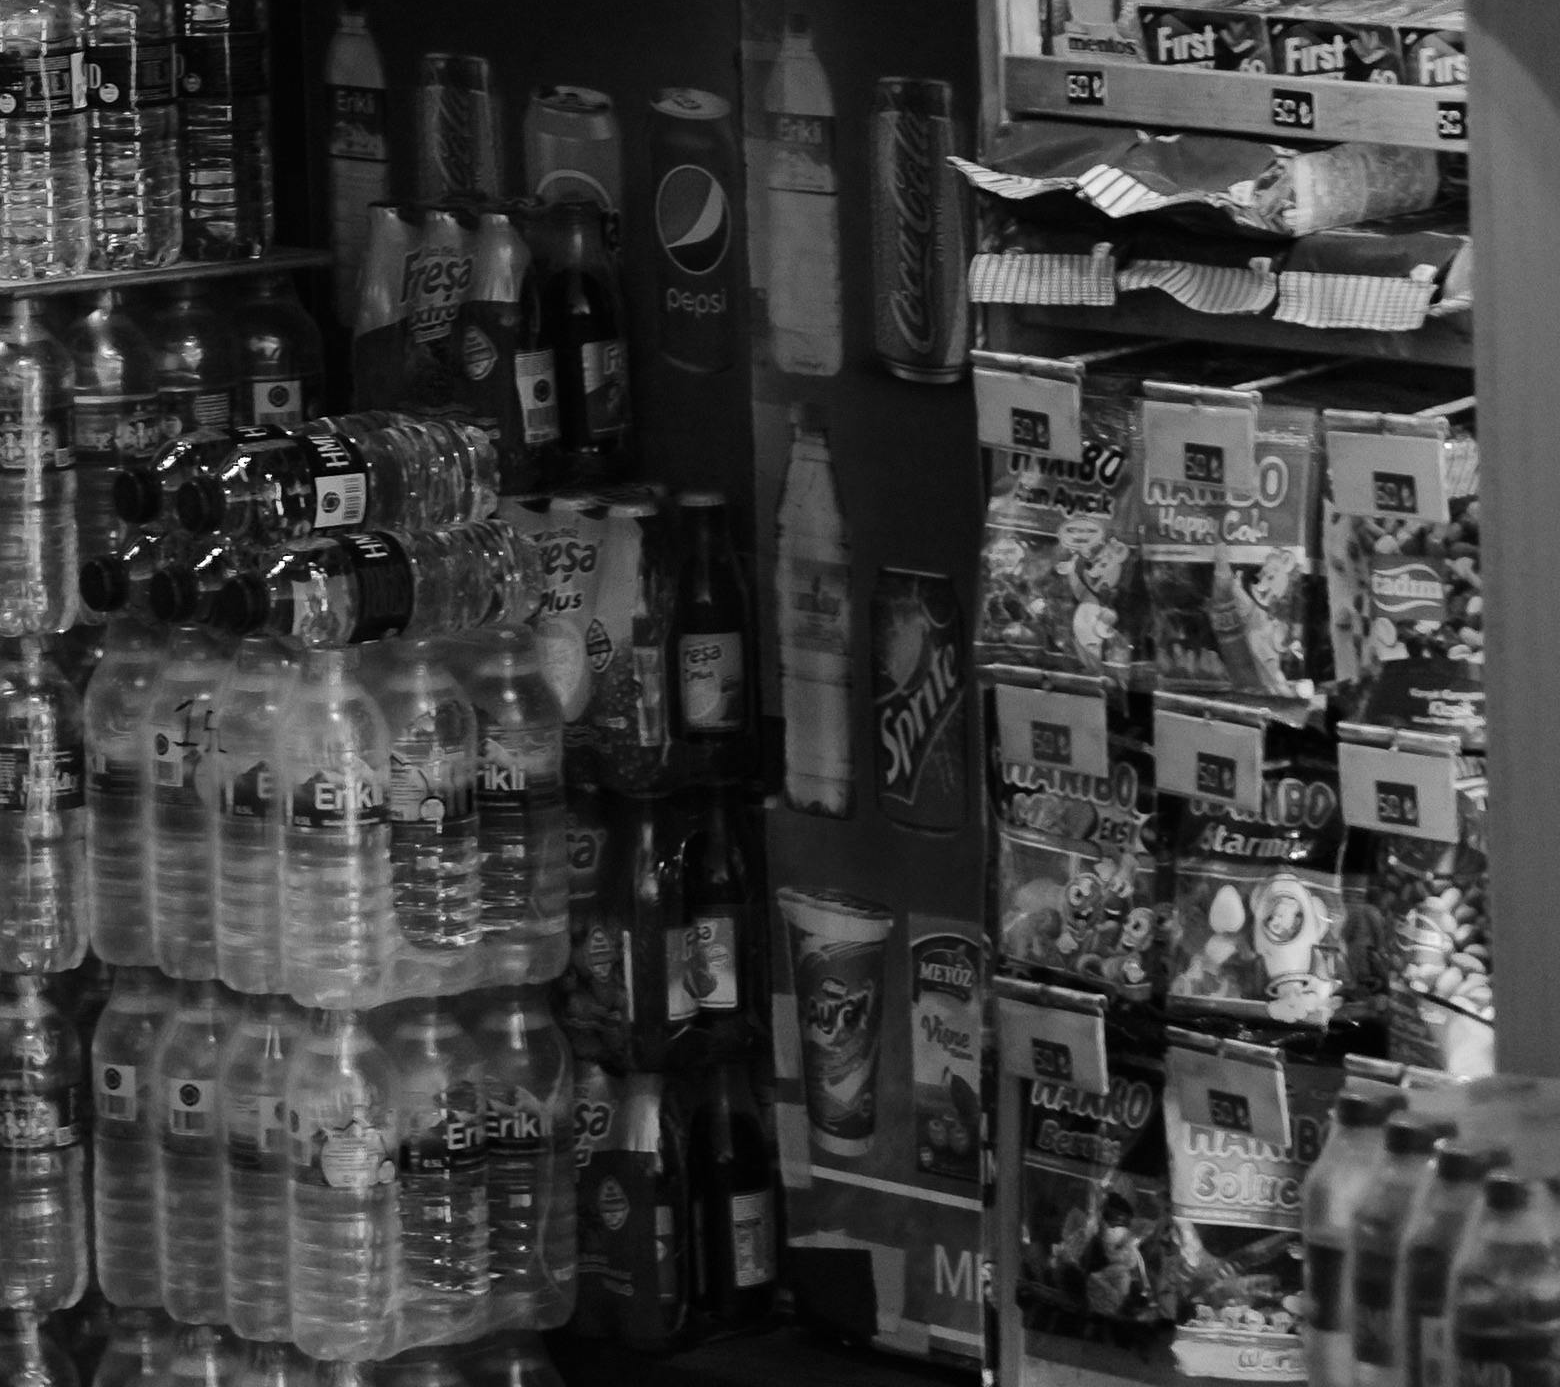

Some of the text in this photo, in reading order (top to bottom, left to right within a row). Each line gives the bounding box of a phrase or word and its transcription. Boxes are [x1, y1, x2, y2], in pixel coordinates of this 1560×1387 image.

[1157, 25, 1215, 62] First
[1285, 34, 1345, 74] First
[1418, 42, 1468, 87] Firs
[665, 287, 728, 318] pepsi
[879, 641, 958, 787] Sprite
